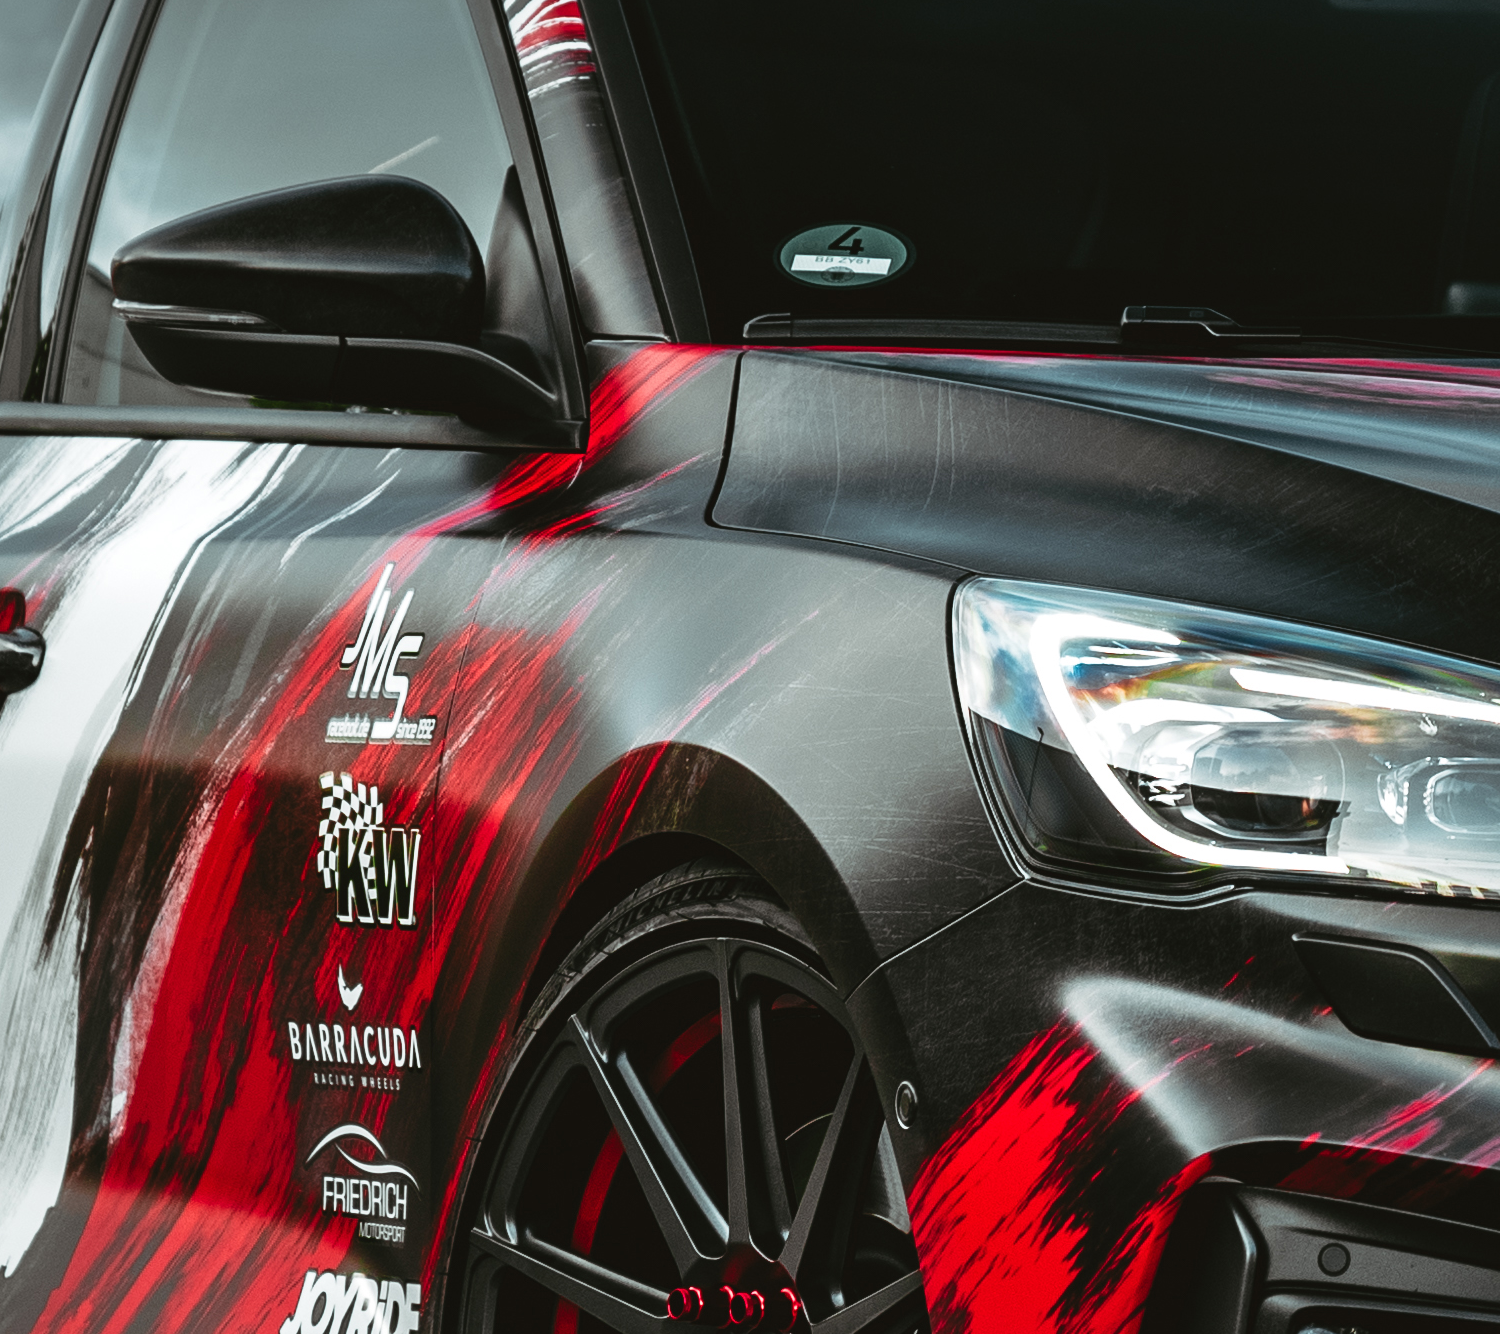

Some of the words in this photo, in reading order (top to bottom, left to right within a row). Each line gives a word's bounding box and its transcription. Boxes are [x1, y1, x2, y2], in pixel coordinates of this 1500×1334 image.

[827, 226, 864, 255] 4
[814, 255, 834, 263] BB
[395, 718, 418, 739] since
[336, 825, 422, 925] KW
[287, 1021, 422, 1069] BARRACUDA
[313, 1072, 355, 1088] RACING
[360, 1076, 401, 1091] WHEELS
[322, 1175, 407, 1221] FRIEDRICH
[358, 1222, 406, 1244] MOTORSPORT
